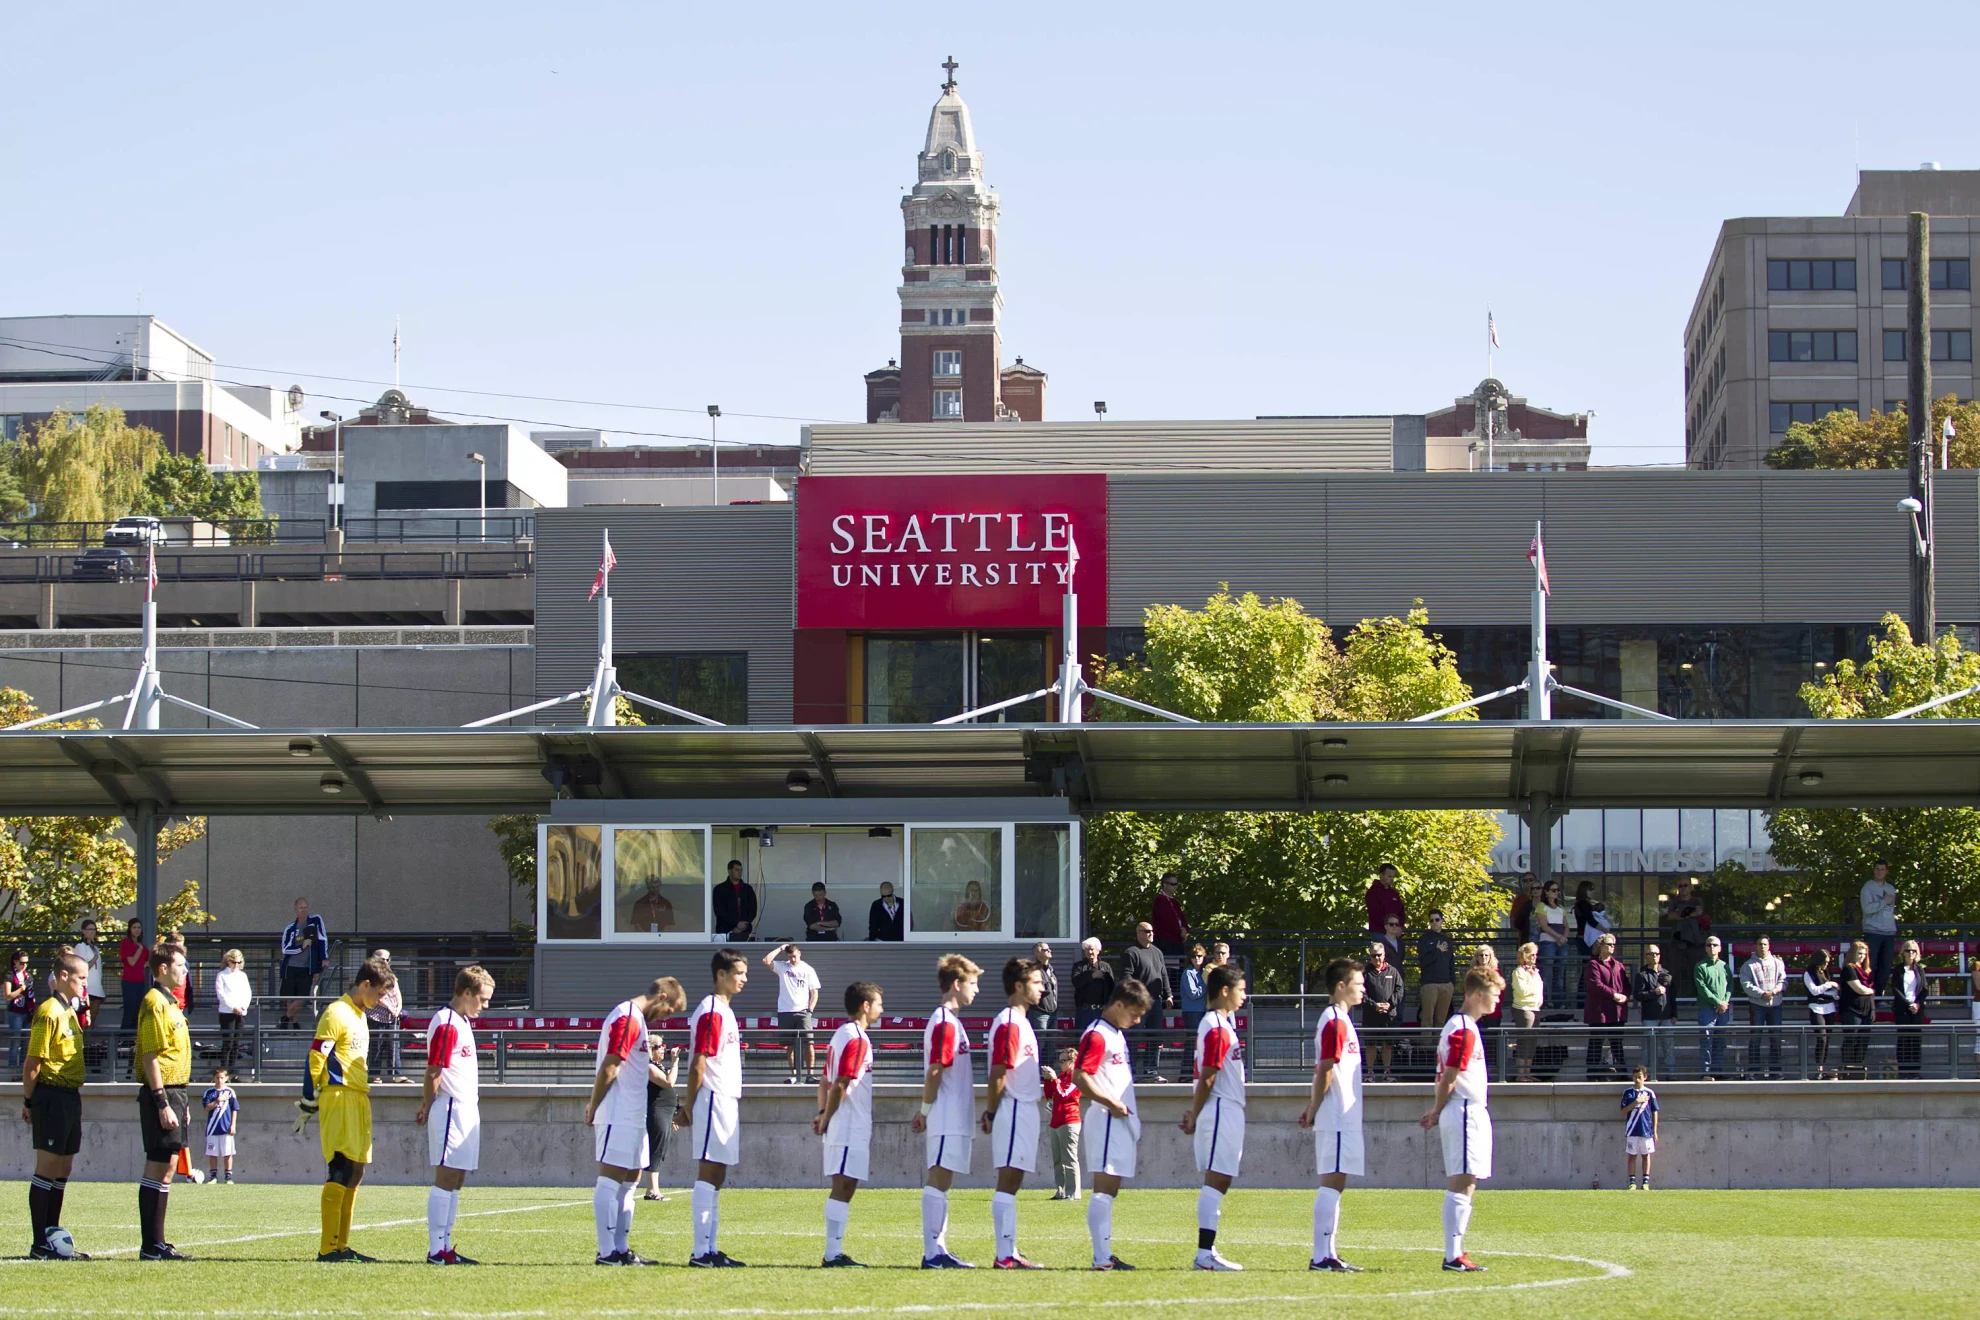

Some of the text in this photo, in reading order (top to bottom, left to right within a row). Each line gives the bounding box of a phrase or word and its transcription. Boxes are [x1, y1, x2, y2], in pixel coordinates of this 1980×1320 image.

[830, 513, 1069, 554] SEATTLE
[831, 563, 1069, 587] UNIVERSITY
[1590, 848, 1714, 874] FITNESS
